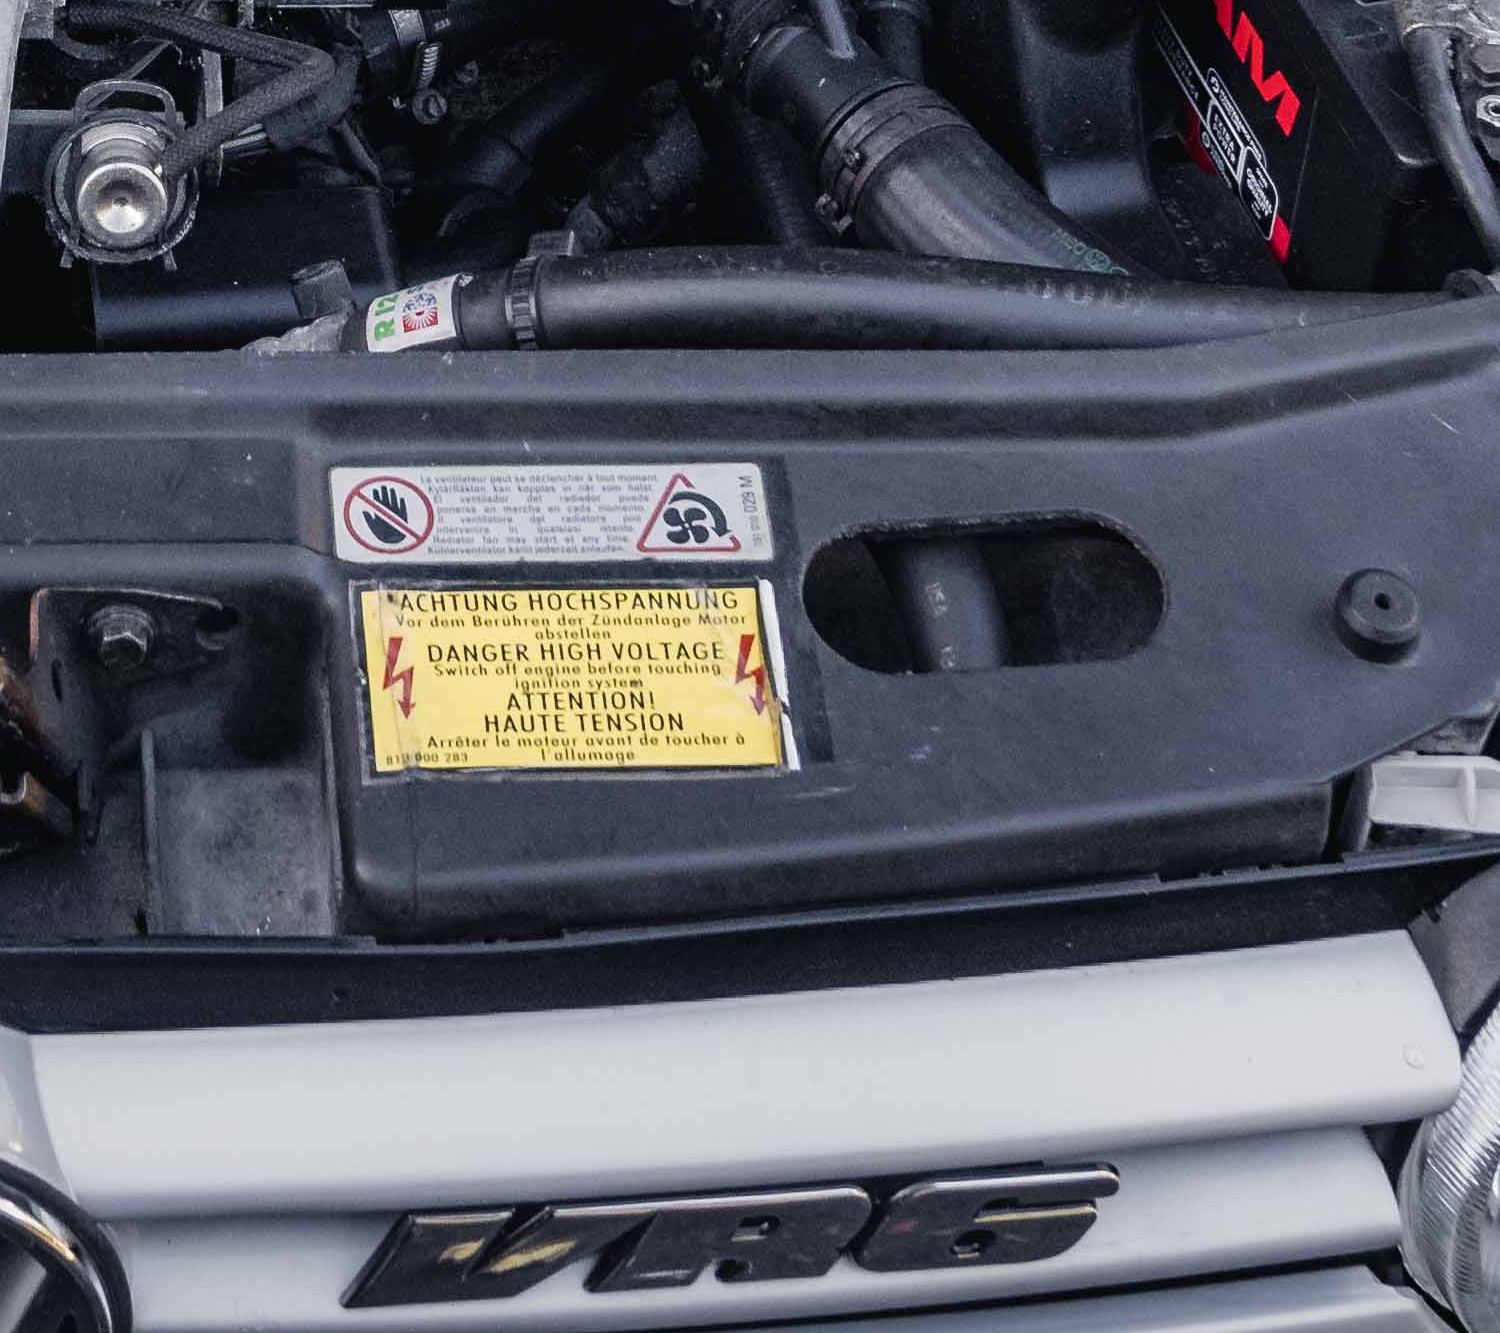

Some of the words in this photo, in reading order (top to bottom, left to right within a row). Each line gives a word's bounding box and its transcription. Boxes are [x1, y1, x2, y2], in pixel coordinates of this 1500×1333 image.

[399, 592, 518, 613] ACHTUNG
[528, 590, 739, 612] HOCHSPANNUNG
[396, 615, 424, 628] Vor
[430, 616, 465, 628] dem
[472, 614, 550, 628] Berühren
[557, 614, 583, 627] der
[591, 613, 692, 629] Zündanlage
[698, 613, 747, 626] Motor
[535, 628, 612, 640] abstellen
[427, 643, 529, 663] DANGER
[541, 643, 601, 662] HIGH
[612, 641, 725, 661] VOLTAGE
[433, 663, 488, 677] Switch
[495, 663, 517, 676] off
[524, 665, 581, 680] engine
[587, 663, 641, 676] before
[648, 663, 722, 677] touching
[515, 678, 581, 692] ignition
[589, 679, 644, 691] system
[507, 691, 656, 711] ATTENTION!
[485, 714, 566, 734] HAUTE
[575, 712, 685, 733] TENSION
[427, 735, 489, 749] Arrêter
[496, 735, 511, 748] le
[518, 736, 577, 748] moteur
[585, 735, 633, 747] avant
[640, 734, 658, 746] de
[665, 733, 729, 746] toucher
[735, 732, 746, 745] à
[540, 748, 636, 764] l'allumage
[340, 1161, 1122, 1310] VR6
